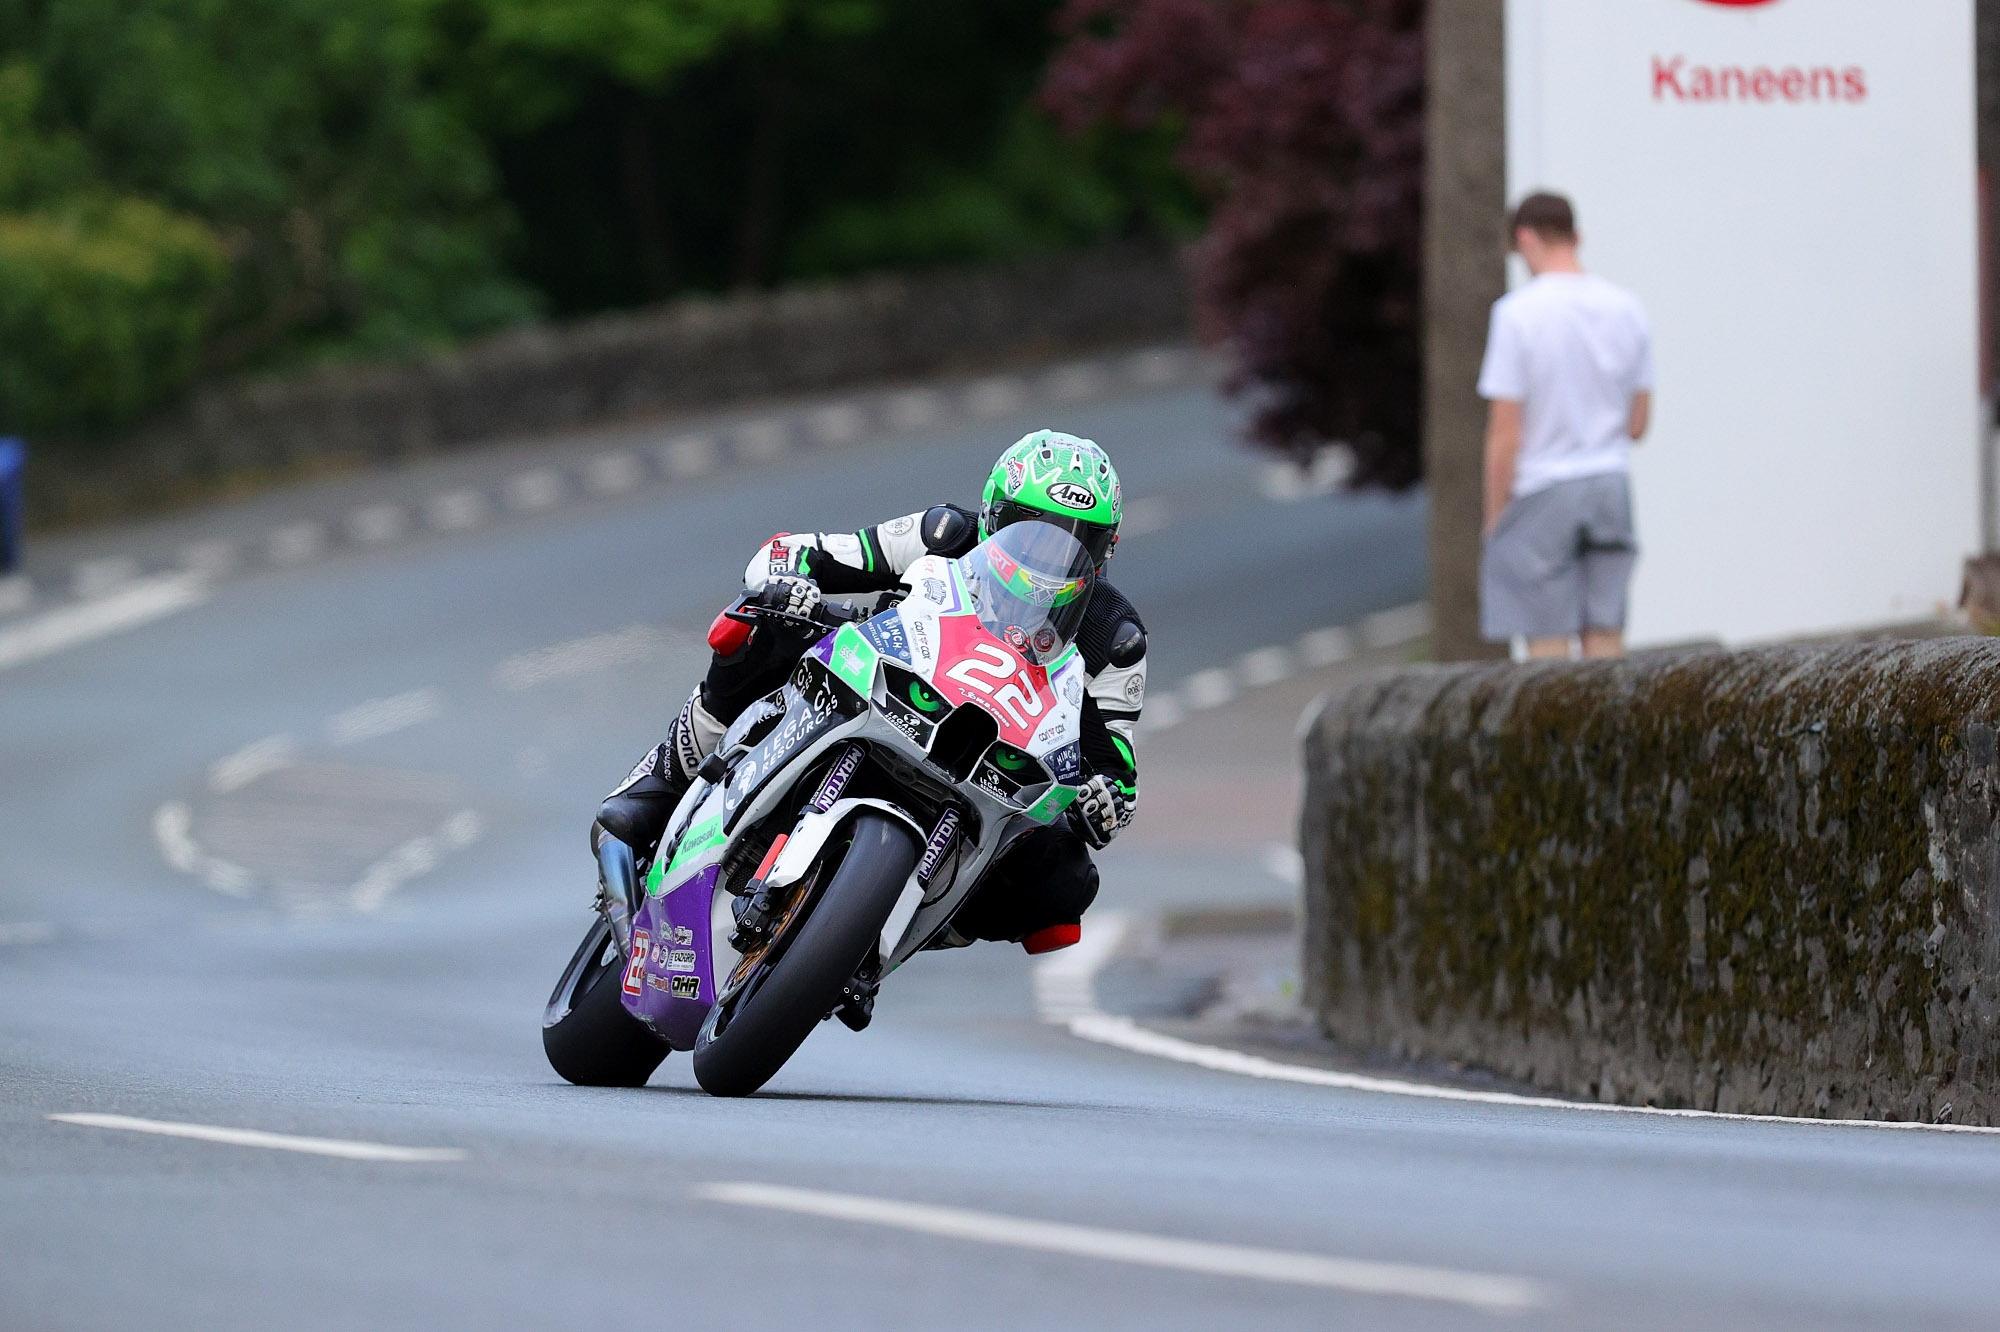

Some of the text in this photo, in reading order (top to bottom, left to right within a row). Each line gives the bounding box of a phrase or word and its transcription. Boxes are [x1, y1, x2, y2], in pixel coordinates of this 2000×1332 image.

[1651, 55, 1869, 103] Kaneens
[1049, 485, 1092, 505] Arai
[882, 618, 903, 649] HINCH
[945, 642, 1044, 731] 22
[679, 699, 700, 769] aytona
[762, 694, 839, 774] RESOURCES
[763, 673, 832, 761] LEGACY
[888, 711, 921, 737] LEGACY
[820, 747, 863, 809] MAXTON
[980, 776, 1008, 798] LEGACY
[681, 823, 719, 855] Kawasaki
[919, 812, 960, 876] MAXTON
